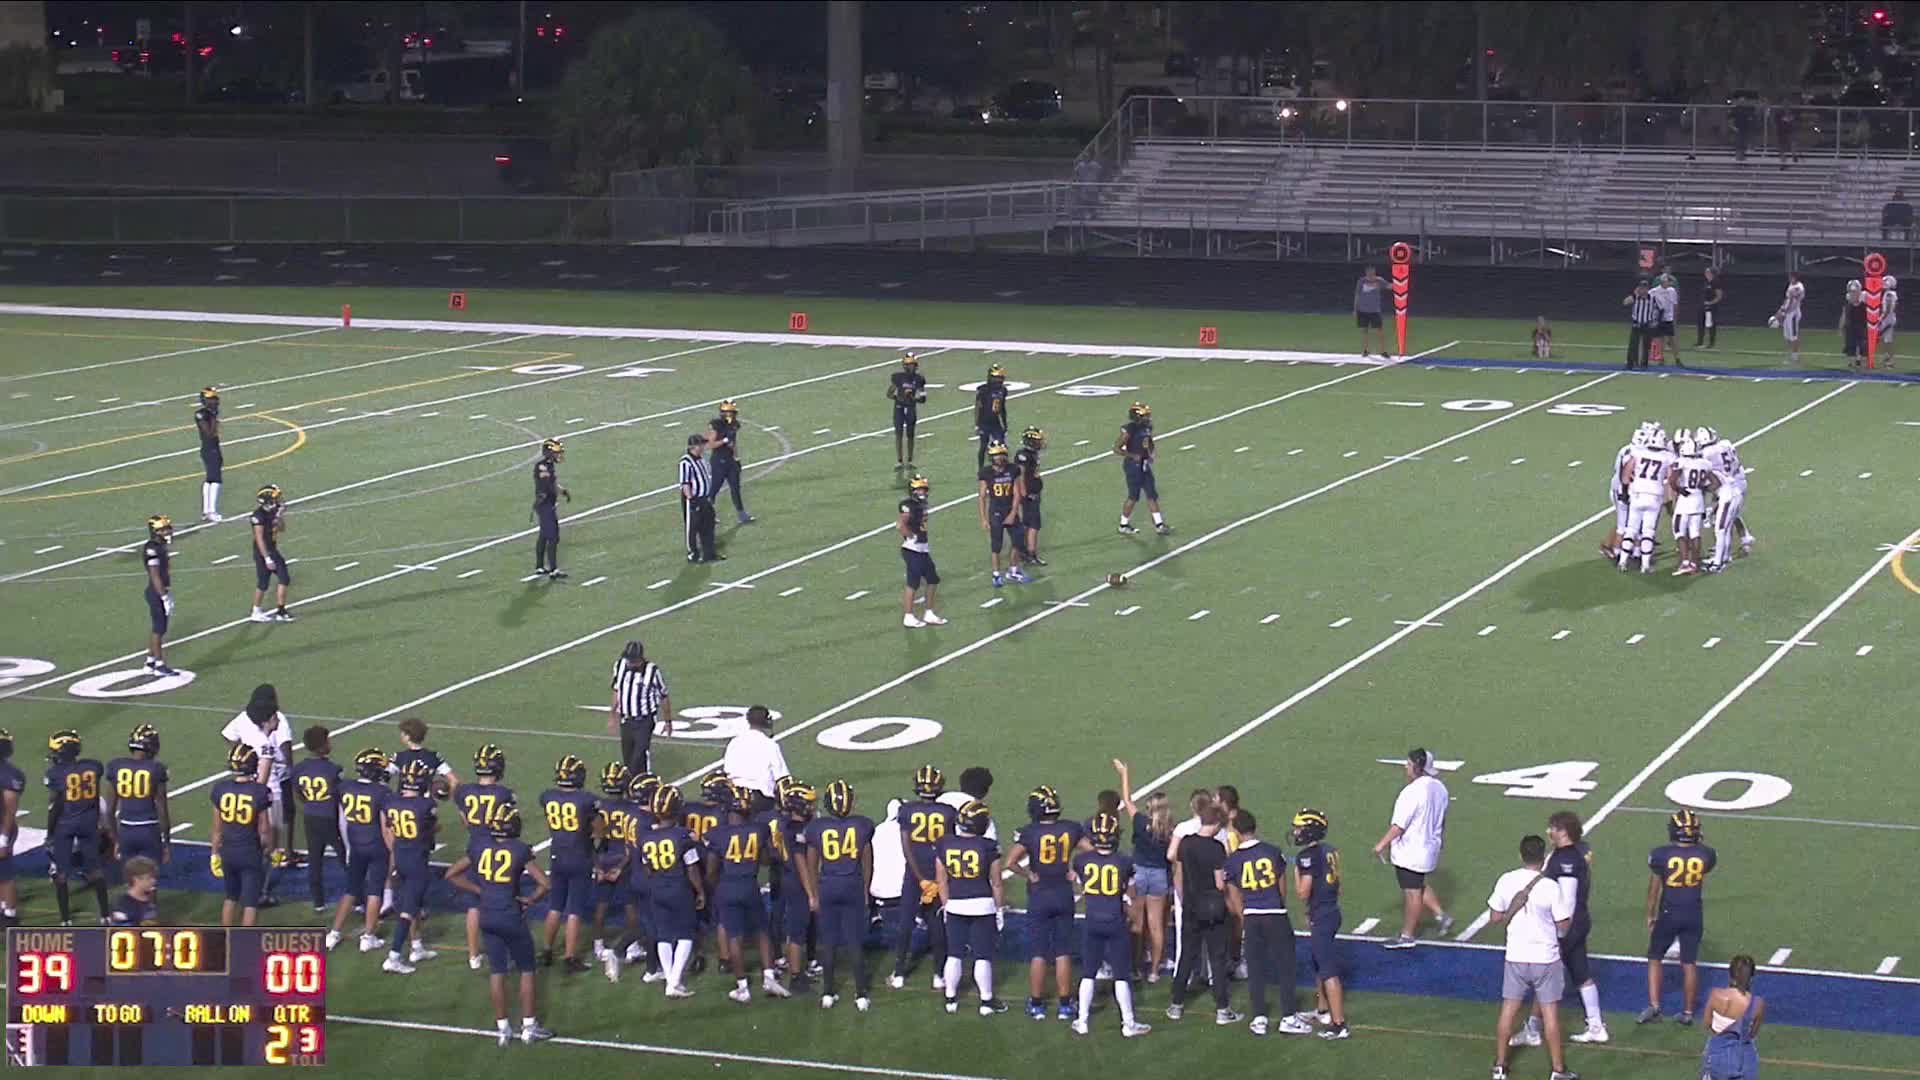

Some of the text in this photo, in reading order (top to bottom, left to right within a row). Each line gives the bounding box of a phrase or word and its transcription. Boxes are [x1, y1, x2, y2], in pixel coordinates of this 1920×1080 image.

[791, 314, 804, 329] 10
[1640, 458, 1662, 481] 77
[66, 770, 97, 801] 83
[116, 768, 151, 798] 80
[298, 775, 332, 801] 32
[219, 792, 253, 825] 95
[342, 793, 372, 824] 25
[388, 808, 418, 839] 36
[465, 794, 497, 825] 27
[545, 801, 580, 832] 88
[910, 811, 945, 843] 26
[641, 838, 676, 871] 38
[725, 827, 758, 863] 44
[821, 826, 859, 861] 64
[1039, 831, 1070, 864] 61
[477, 848, 512, 883] 42
[945, 849, 980, 879] 53
[1083, 863, 1119, 896] 20
[1240, 857, 1276, 891] 43
[1665, 856, 1704, 887] 28
